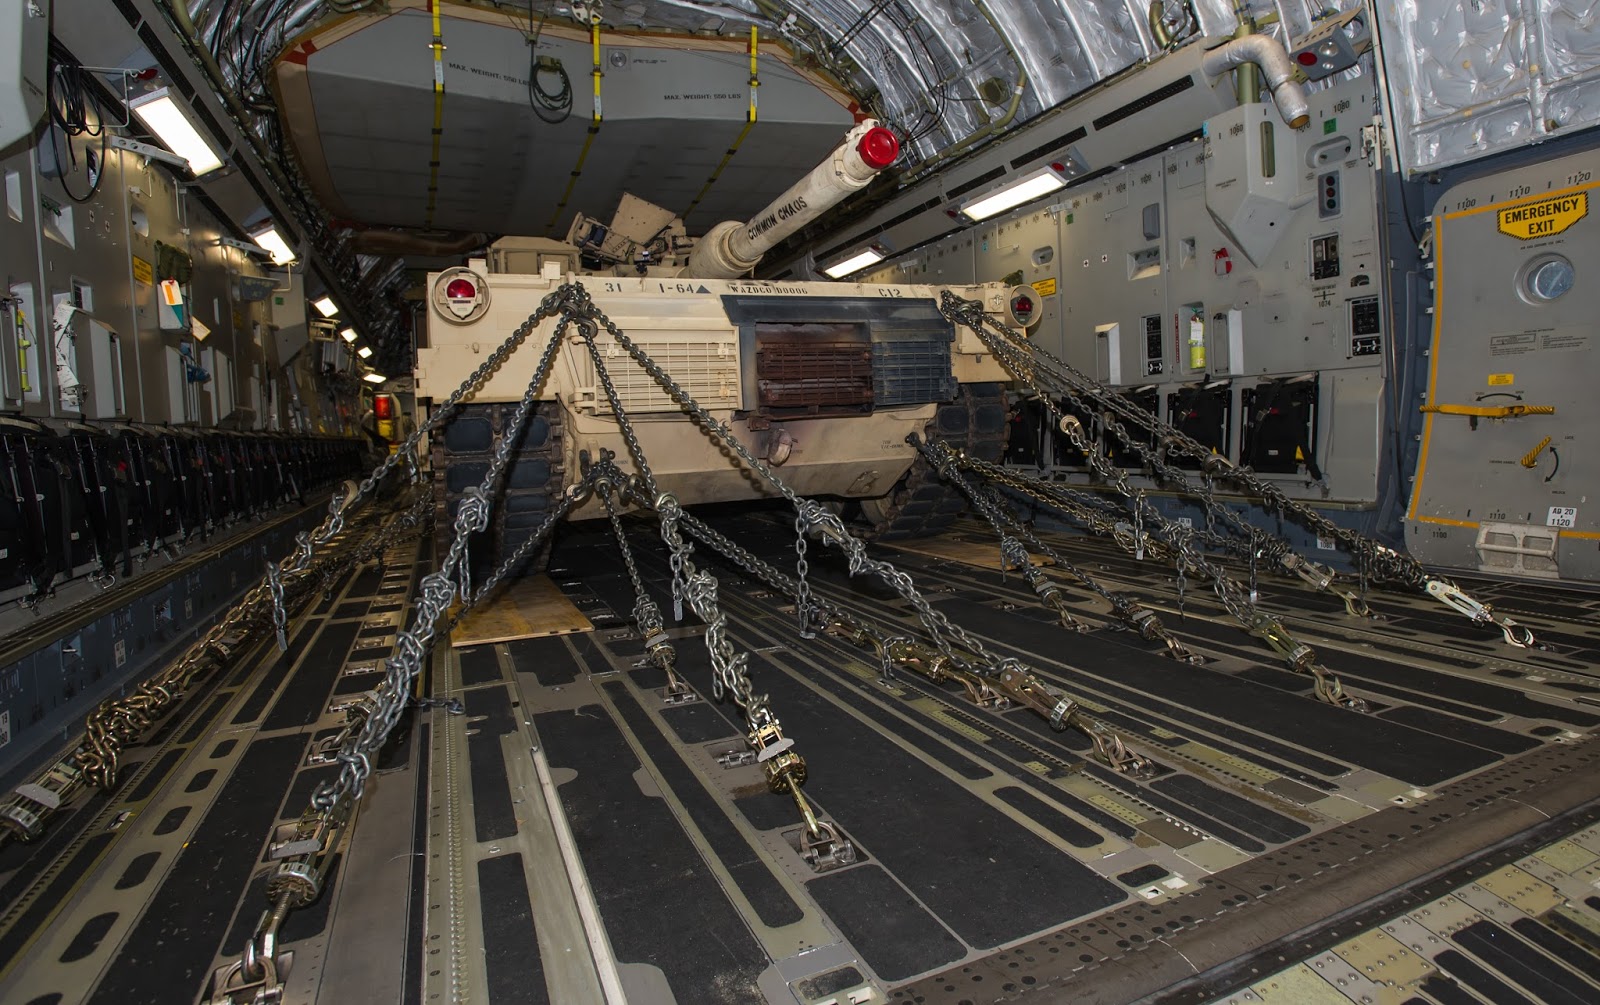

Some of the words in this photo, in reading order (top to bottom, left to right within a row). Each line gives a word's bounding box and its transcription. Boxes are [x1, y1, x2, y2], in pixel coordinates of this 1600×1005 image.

[449, 62, 469, 72] MAX.
[470, 67, 501, 80] WEIGHT:
[1567, 171, 1591, 185] 1120
[1509, 186, 1531, 198] 1110
[1456, 198, 1477, 210] 1100
[1505, 198, 1579, 224] EMERGENCY
[748, 213, 778, 240] COMMON
[778, 196, 807, 220] CHAOS
[1528, 219, 1555, 235] EXIT
[605, 282, 622, 293] 31
[659, 283, 694, 294] 1-64
[878, 288, 903, 298] C12
[1552, 518, 1570, 526] 1120
[1432, 531, 1447, 539] 1100
